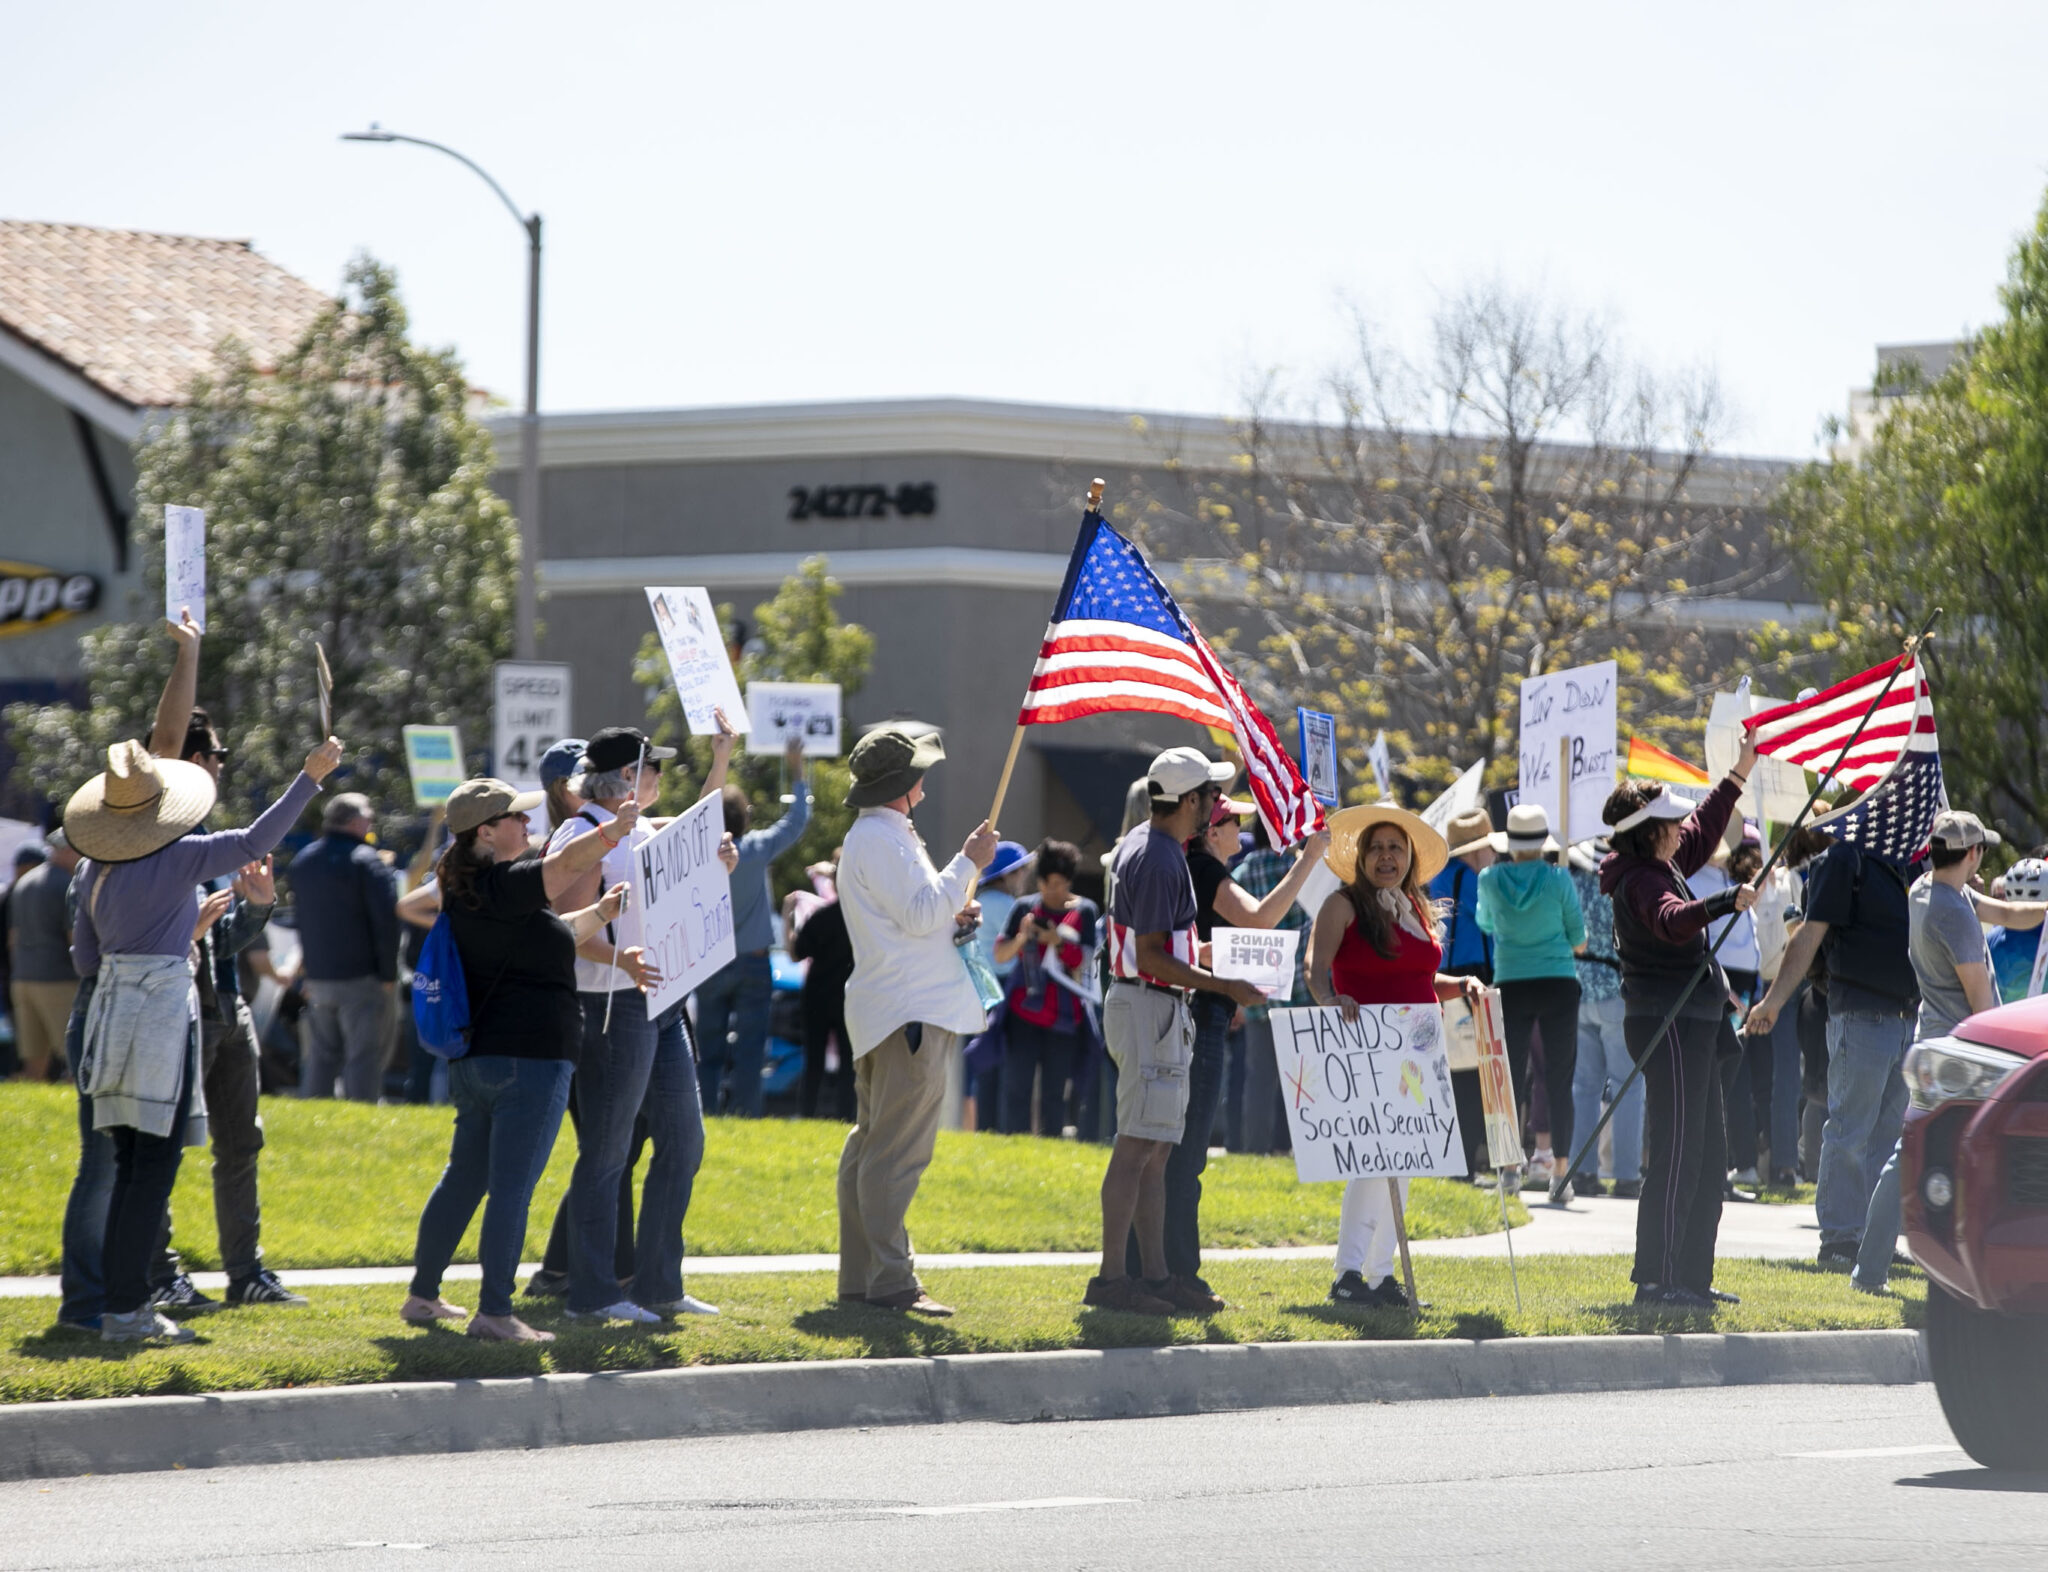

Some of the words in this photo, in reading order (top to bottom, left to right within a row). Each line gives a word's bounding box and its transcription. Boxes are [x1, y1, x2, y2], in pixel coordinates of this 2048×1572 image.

[641, 825, 691, 910] HANDS
[691, 806, 709, 868] OFF
[1288, 1004, 1403, 1054] HANDS
[1324, 1050, 1384, 1103] OFF
[1299, 1101, 1381, 1141] Social
[1383, 1096, 1455, 1159] Secuity
[1333, 1137, 1434, 1175] Medicaid
